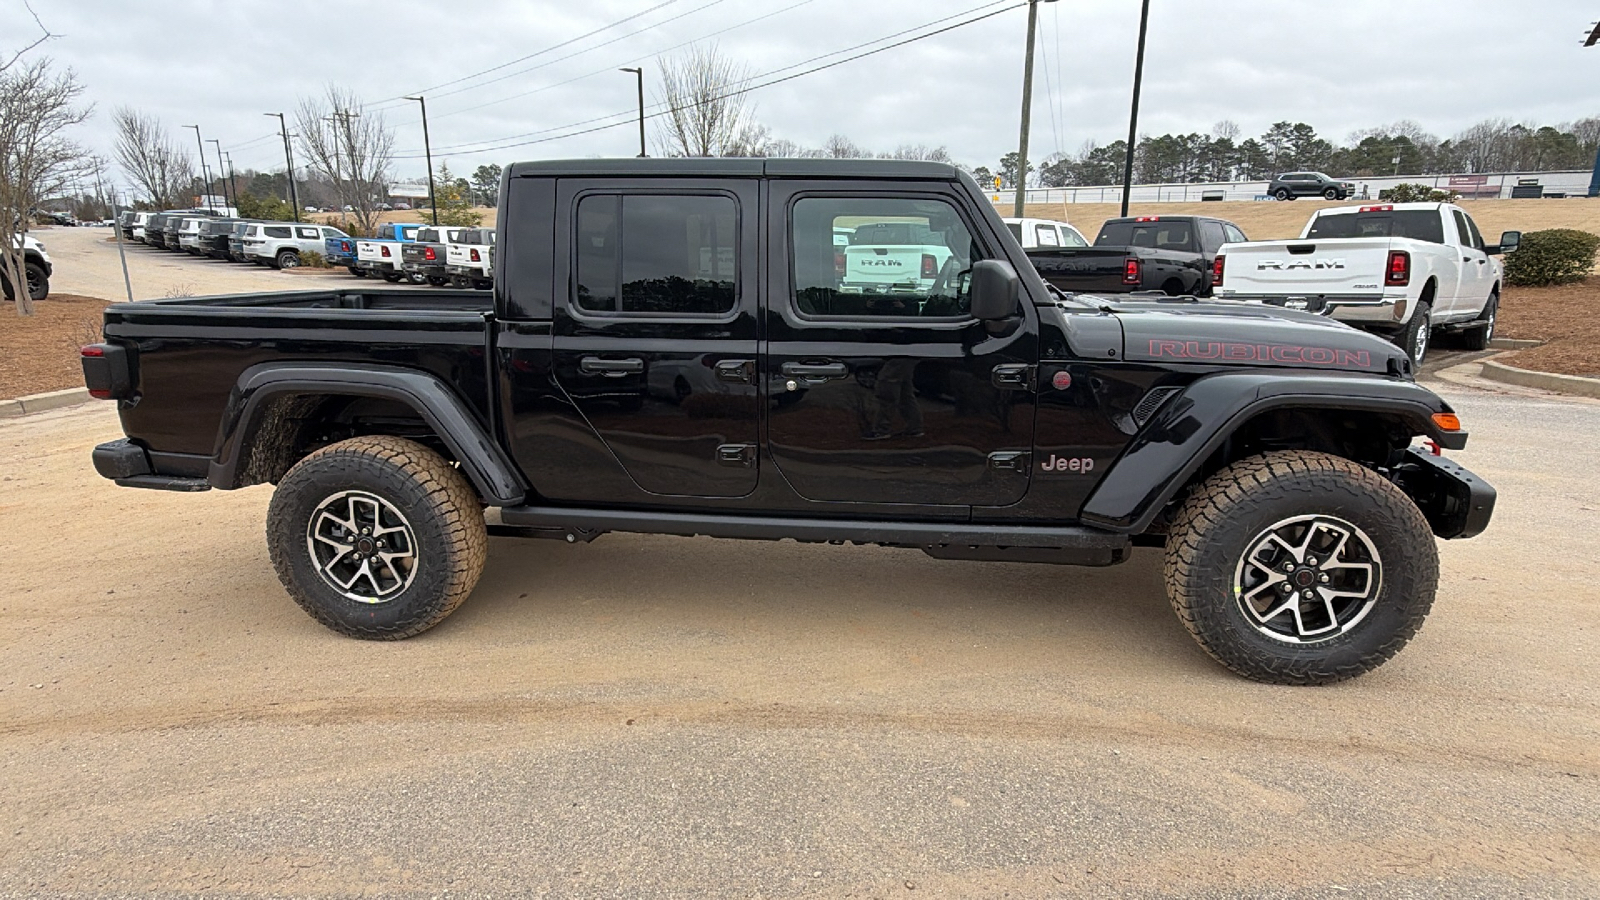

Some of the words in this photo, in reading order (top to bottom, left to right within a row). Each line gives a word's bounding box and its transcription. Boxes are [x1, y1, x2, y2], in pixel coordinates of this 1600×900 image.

[1040, 262, 1098, 271] RAM
[1257, 258, 1346, 271] RAM
[1150, 339, 1371, 367] RUBICON
[1041, 454, 1094, 474] Jeep
